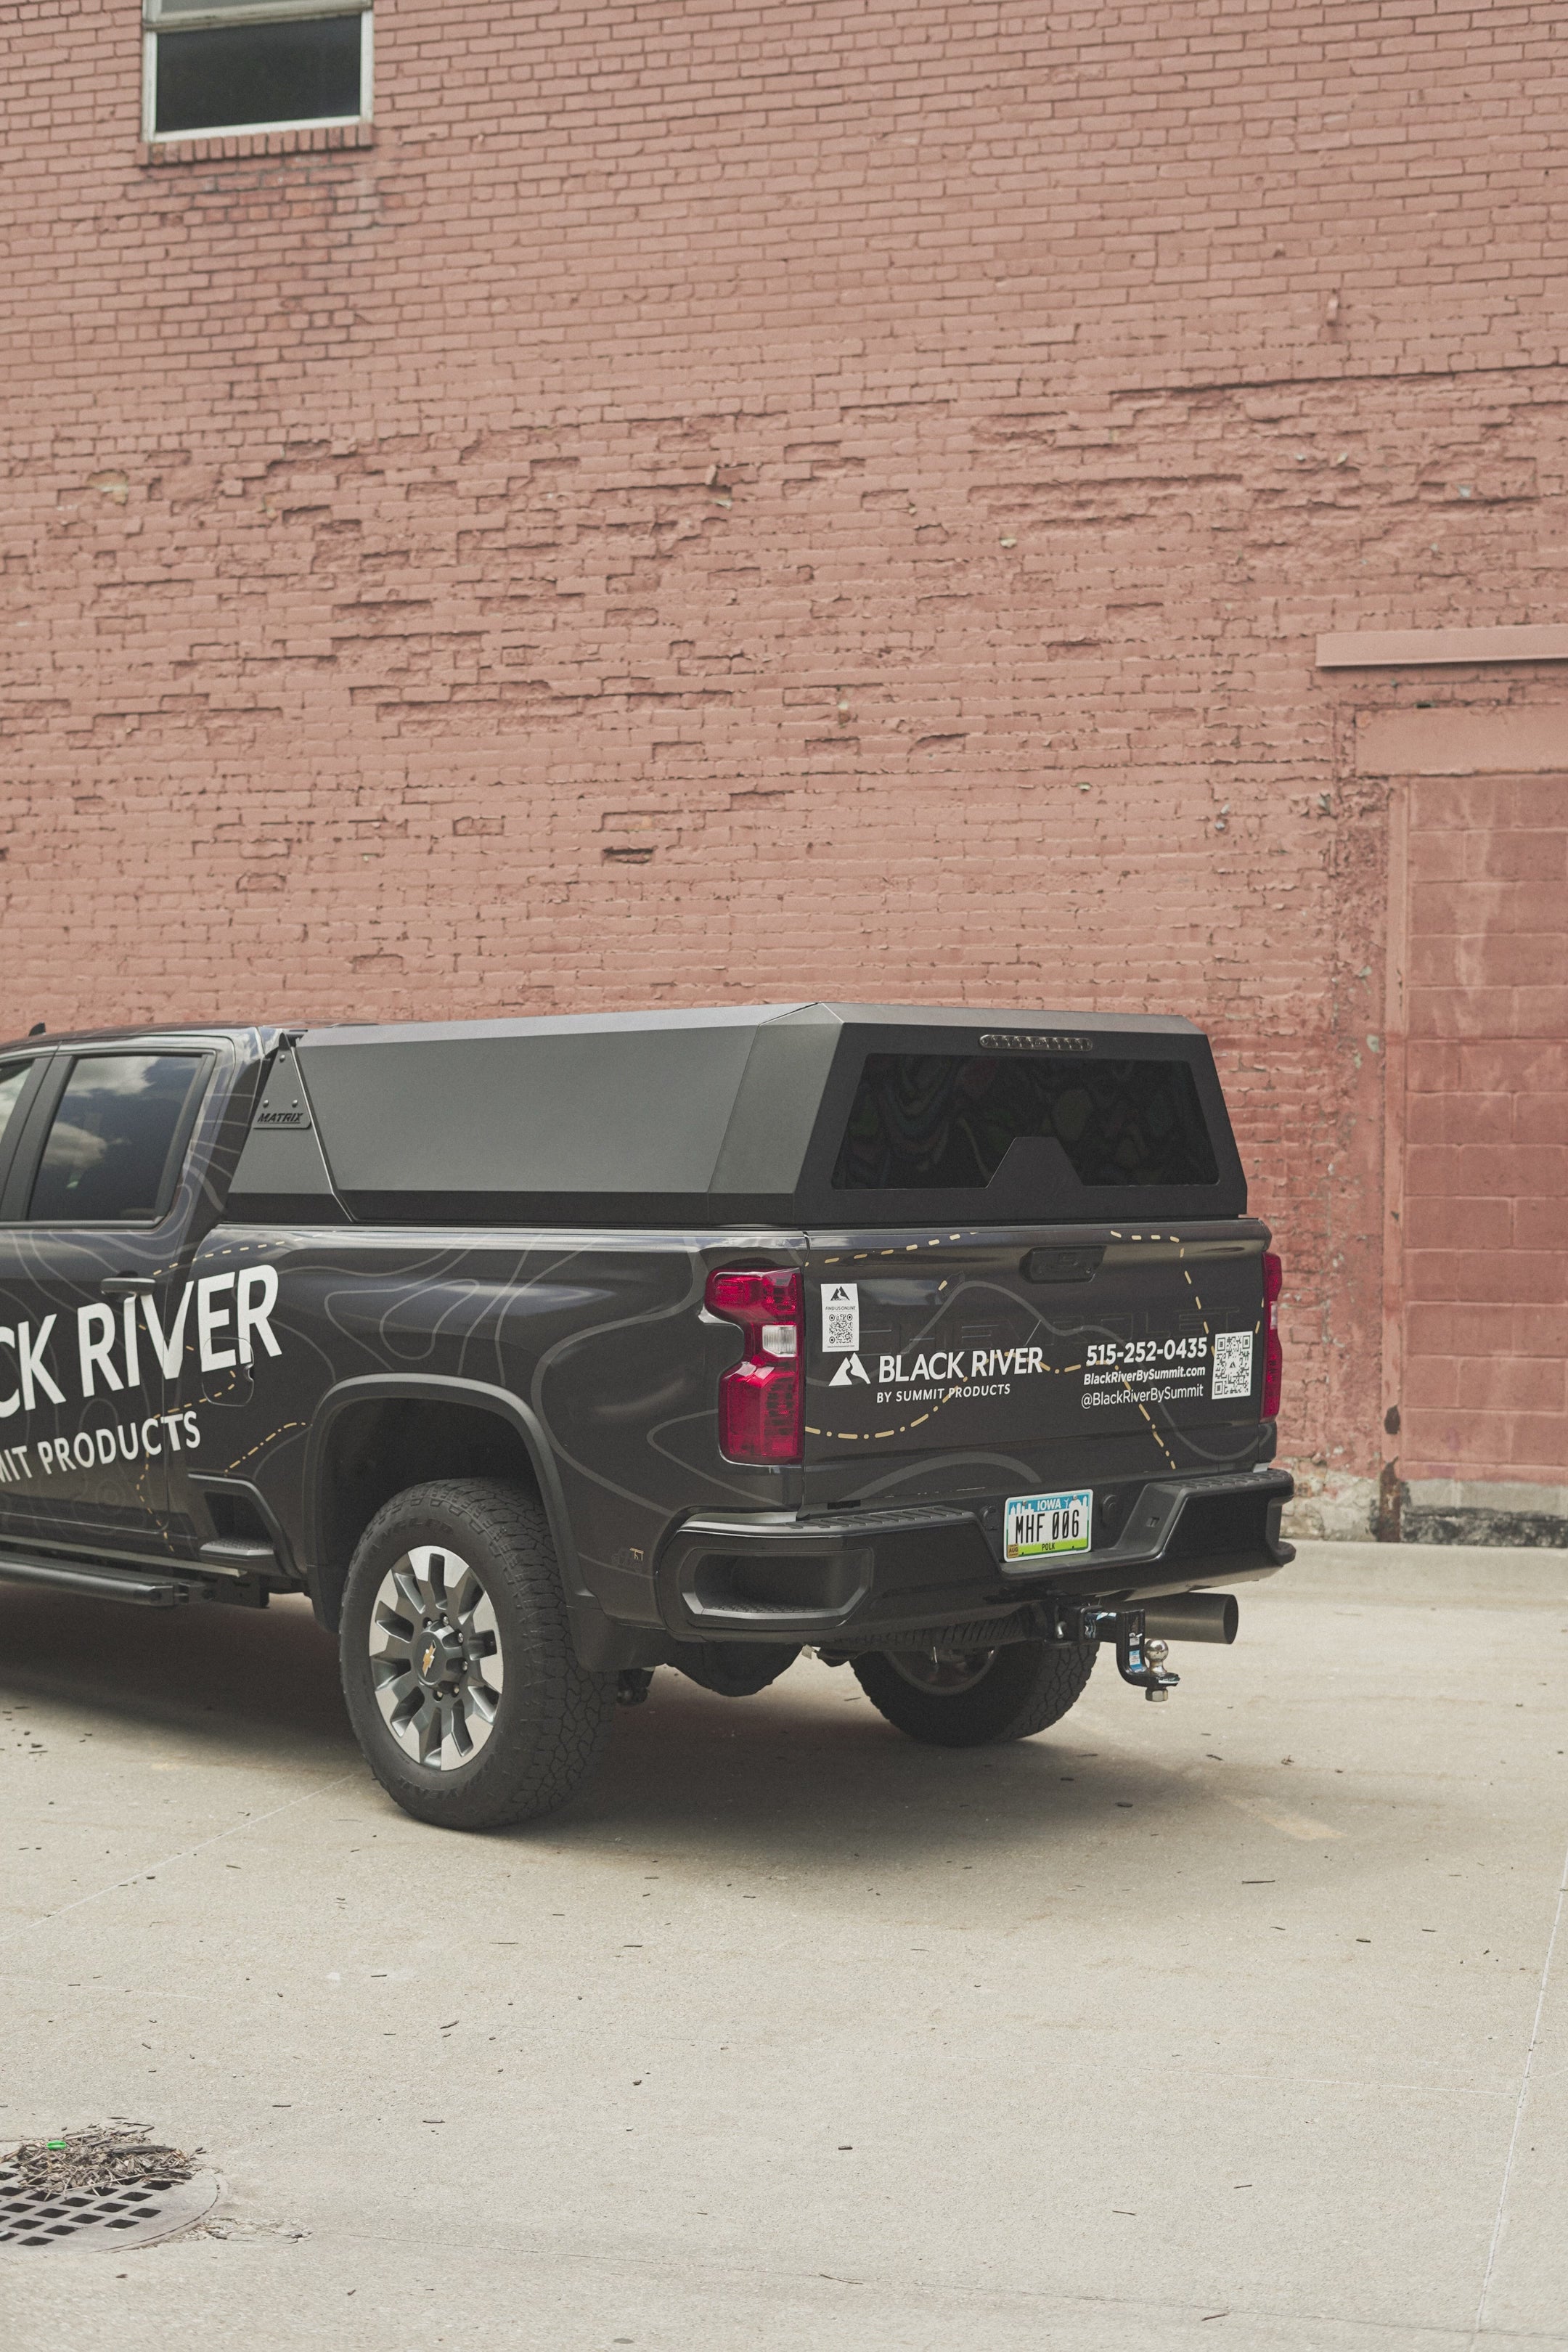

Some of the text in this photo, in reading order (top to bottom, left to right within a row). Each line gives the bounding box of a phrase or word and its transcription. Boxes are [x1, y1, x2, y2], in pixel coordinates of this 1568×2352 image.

[257, 1112, 303, 1122] MATRIX
[78, 1265, 282, 1397] RIVER
[1086, 1337, 1206, 1367] 515-252-0435
[879, 1347, 1042, 1383] BLACK RIVER
[1084, 1365, 1206, 1385] BlackRiverBySummit.com
[877, 1384, 1010, 1402] BY SUMMIT PRODUCTS
[1082, 1384, 1204, 1409] @BlackRiverBySummit
[38, 1411, 200, 1475] PRODUCTS
[1037, 1498, 1061, 1511] IOWA
[1015, 1509, 1079, 1544] MHF 006
[1042, 1543, 1055, 1551] POLK
